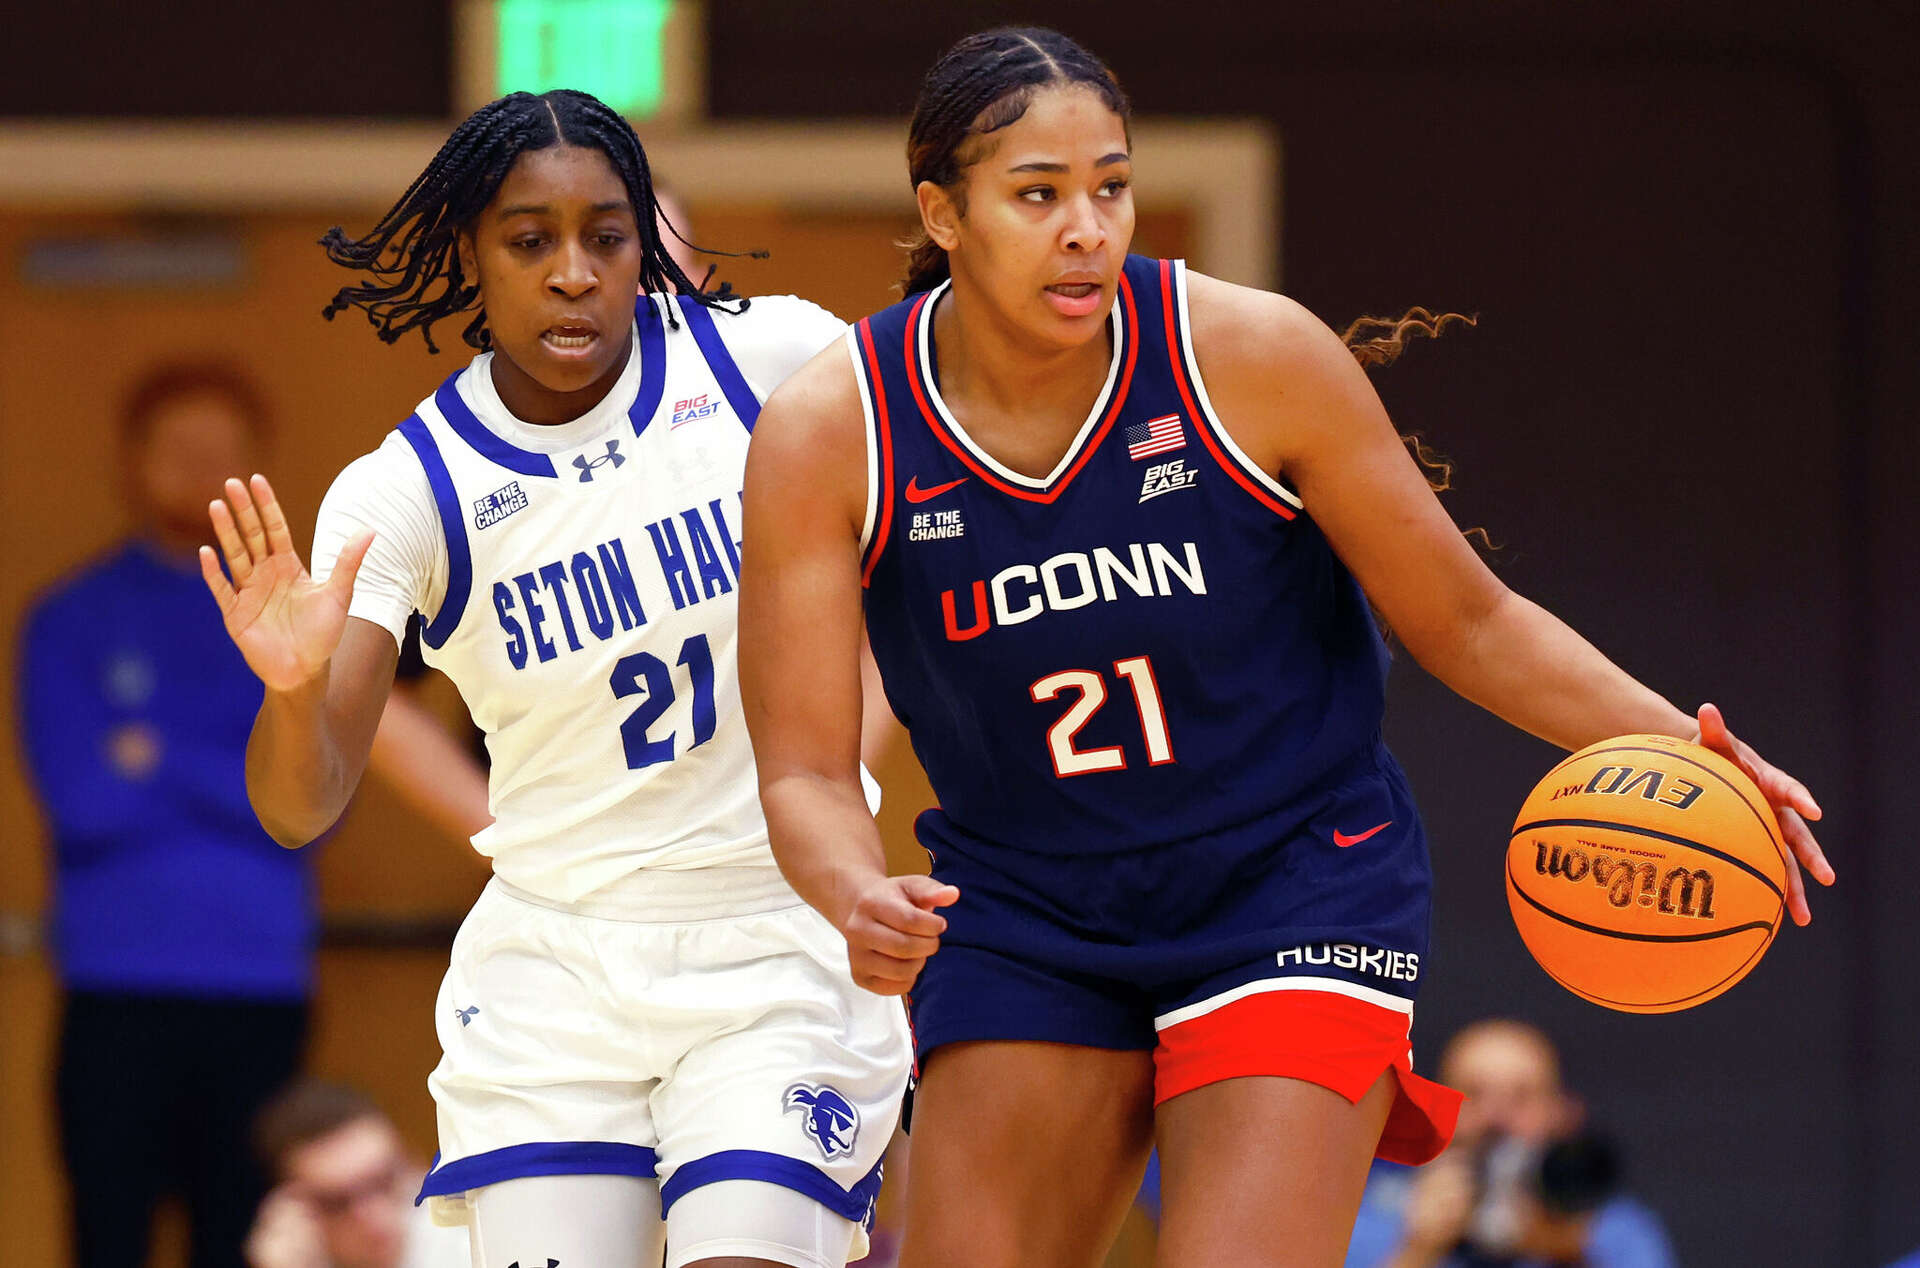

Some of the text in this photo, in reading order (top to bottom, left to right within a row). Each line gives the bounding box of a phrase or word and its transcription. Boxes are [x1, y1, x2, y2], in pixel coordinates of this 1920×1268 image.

[672, 401, 721, 424] EAST
[674, 394, 708, 413] BIG
[1141, 469, 1199, 496] EAST
[1144, 459, 1185, 482] BIG
[473, 481, 521, 515] BE THE
[475, 492, 528, 530] CHANGE
[909, 523, 965, 542] CHANGE
[913, 510, 961, 529] BE THE
[493, 491, 743, 671] SETON HAL
[940, 542, 1208, 642] UCONN
[609, 633, 717, 770] 21
[1028, 655, 1177, 779] 21
[1550, 766, 1706, 810] EVO NXT
[1576, 839, 1598, 849] BALL
[1600, 845, 1628, 854] GAME
[1535, 840, 1716, 920] Wilson
[1276, 943, 1420, 982] HUSKIES
